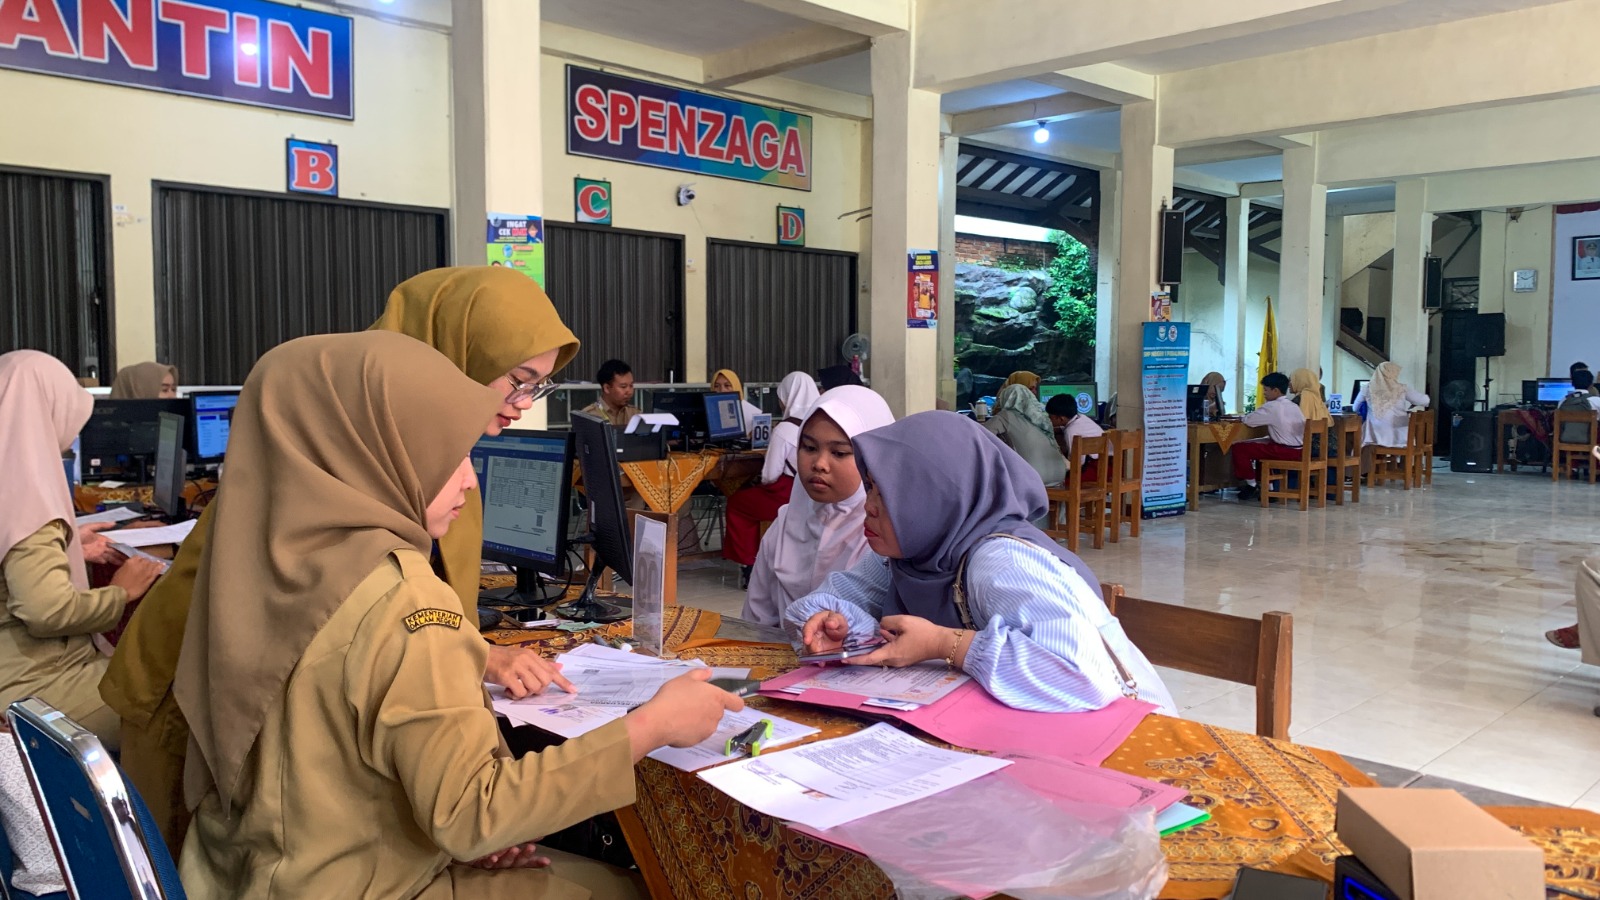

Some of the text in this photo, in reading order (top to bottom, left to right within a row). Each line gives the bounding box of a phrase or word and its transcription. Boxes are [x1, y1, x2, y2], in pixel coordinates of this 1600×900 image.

[0, 0, 333, 99] ANTIN
[574, 84, 807, 177] SPENZAGA
[292, 147, 334, 191] B
[578, 185, 609, 220] C
[780, 212, 804, 241] D
[1330, 400, 1341, 409] 03
[754, 425, 769, 441] 06
[407, 610, 458, 623] KEMENTERIAN
